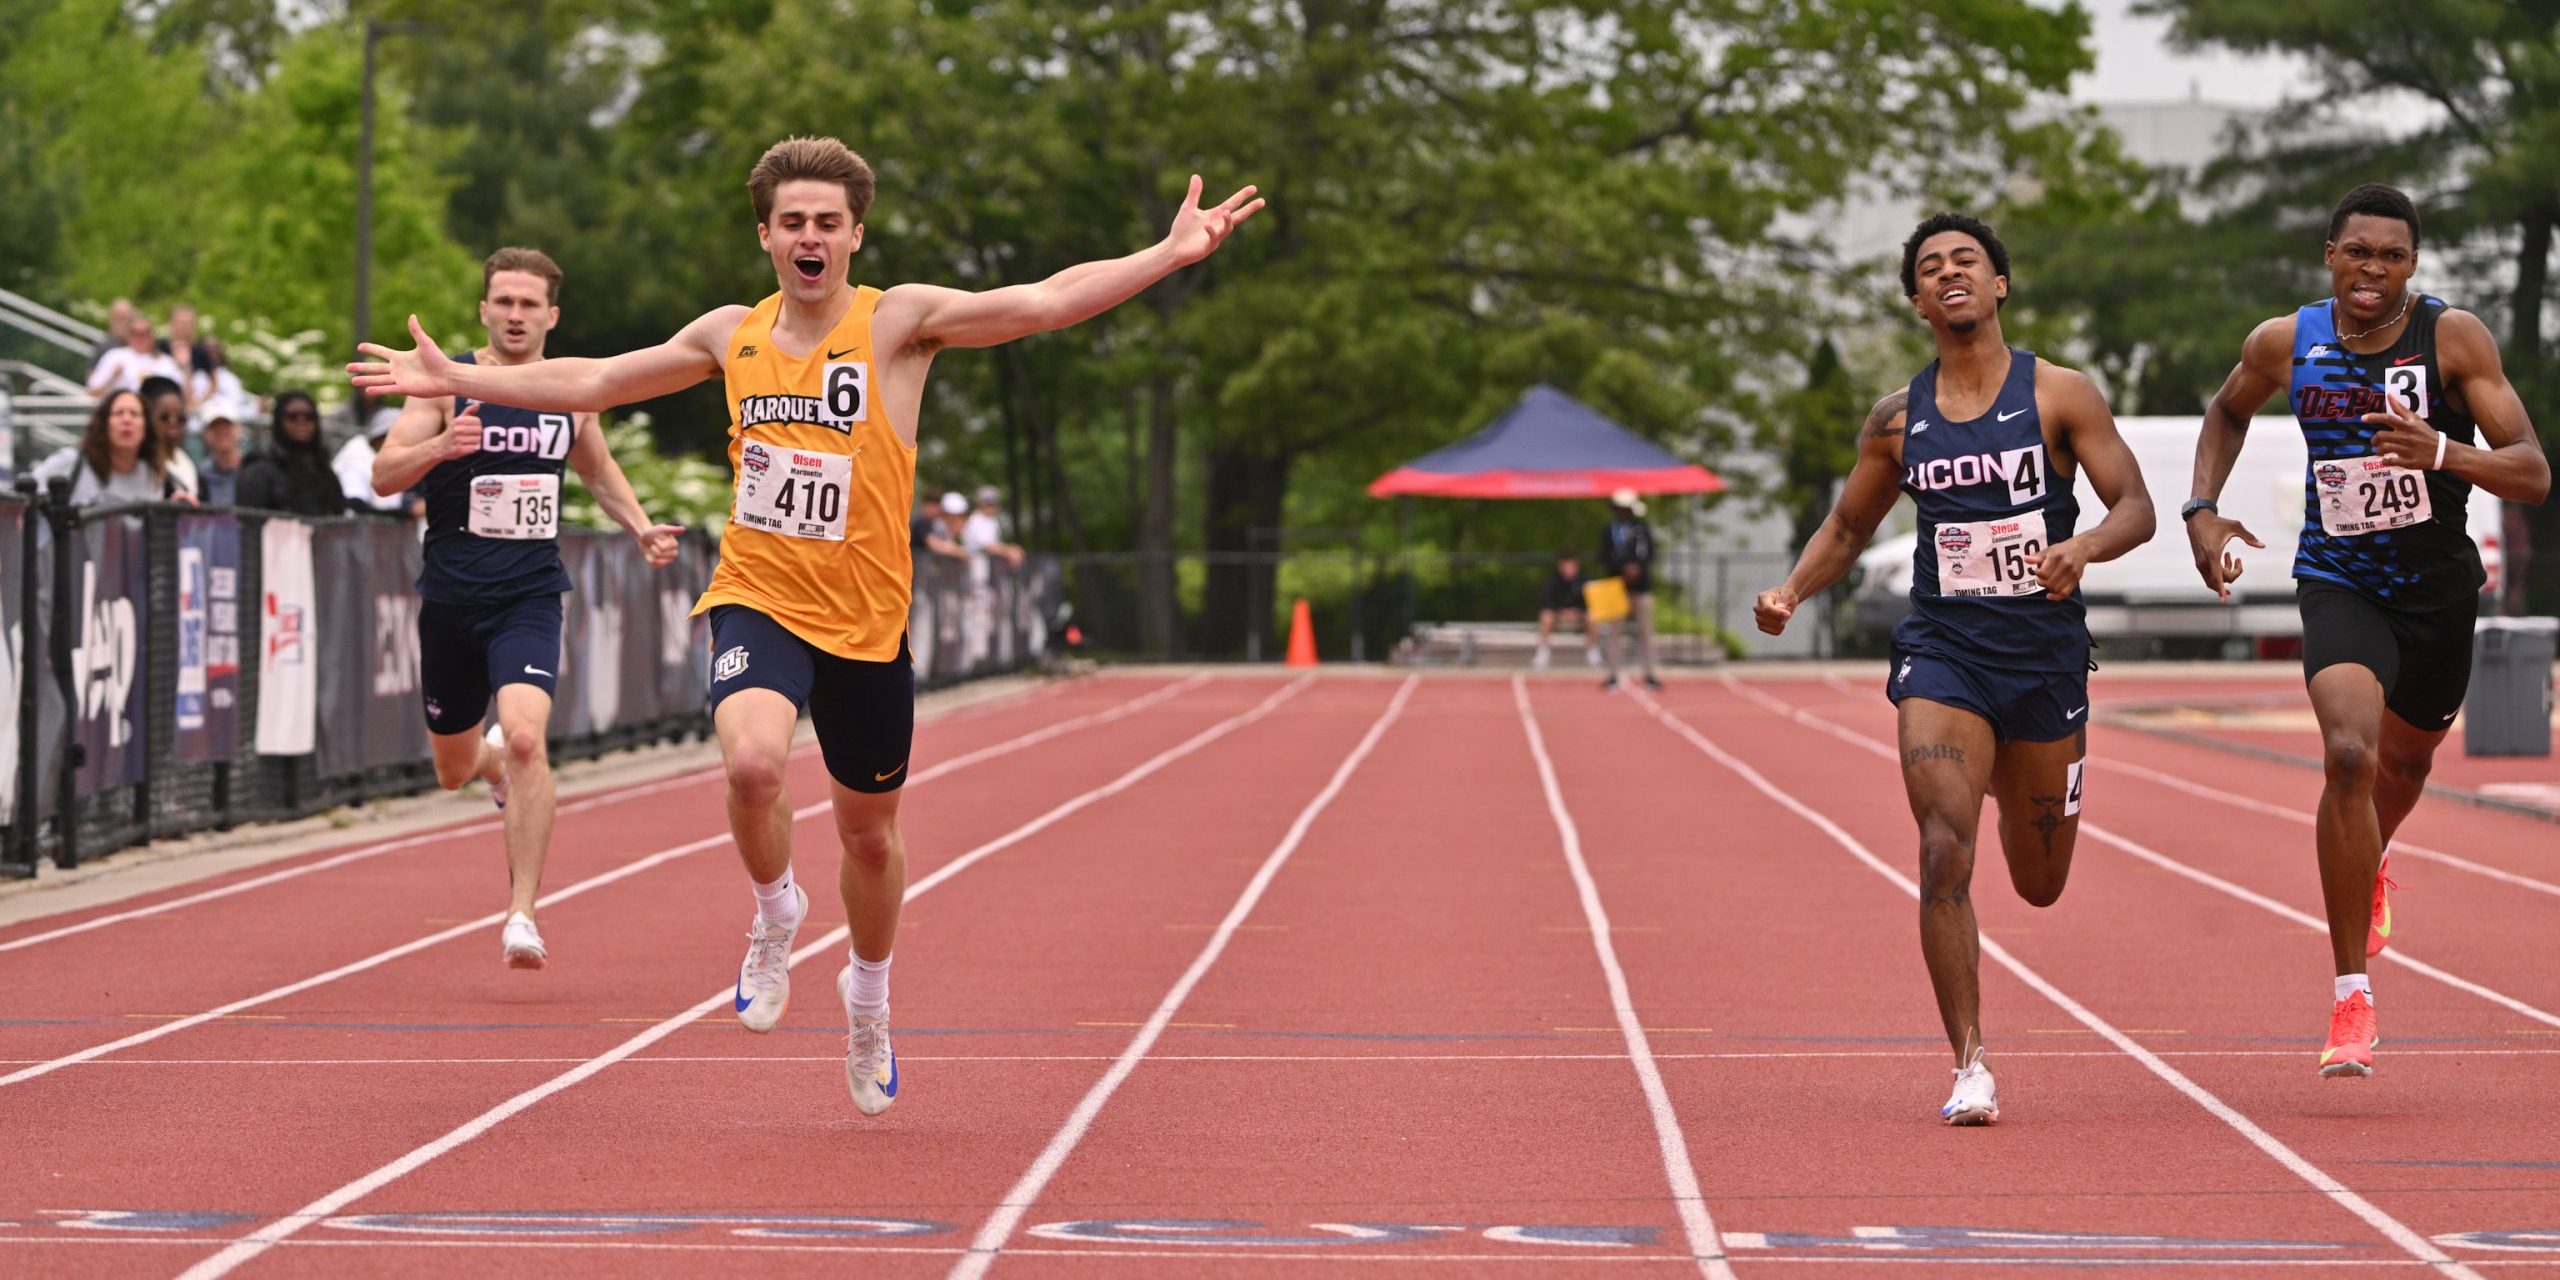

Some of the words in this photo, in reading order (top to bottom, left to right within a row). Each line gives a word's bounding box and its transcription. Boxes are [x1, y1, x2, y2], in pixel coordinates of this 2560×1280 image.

[828, 366, 860, 417] 6
[2390, 369, 2420, 414] 3
[544, 419, 563, 455] 7
[791, 467, 823, 478] Marquette
[792, 453, 822, 468] Olsen
[2012, 450, 2040, 497] 4
[512, 496, 552, 525] 135
[774, 478, 840, 522] 410
[2359, 474, 2420, 518] 249
[743, 512, 767, 527] TIMING
[768, 518, 782, 529] TAG
[1991, 522, 2019, 536] Stone
[2336, 523, 2360, 532] TIMING
[2361, 521, 2375, 530] TAG
[1985, 539, 2040, 582] 159
[1954, 587, 1981, 597] TIMING
[1982, 586, 1997, 595] TAG
[2069, 763, 2083, 808] 4
